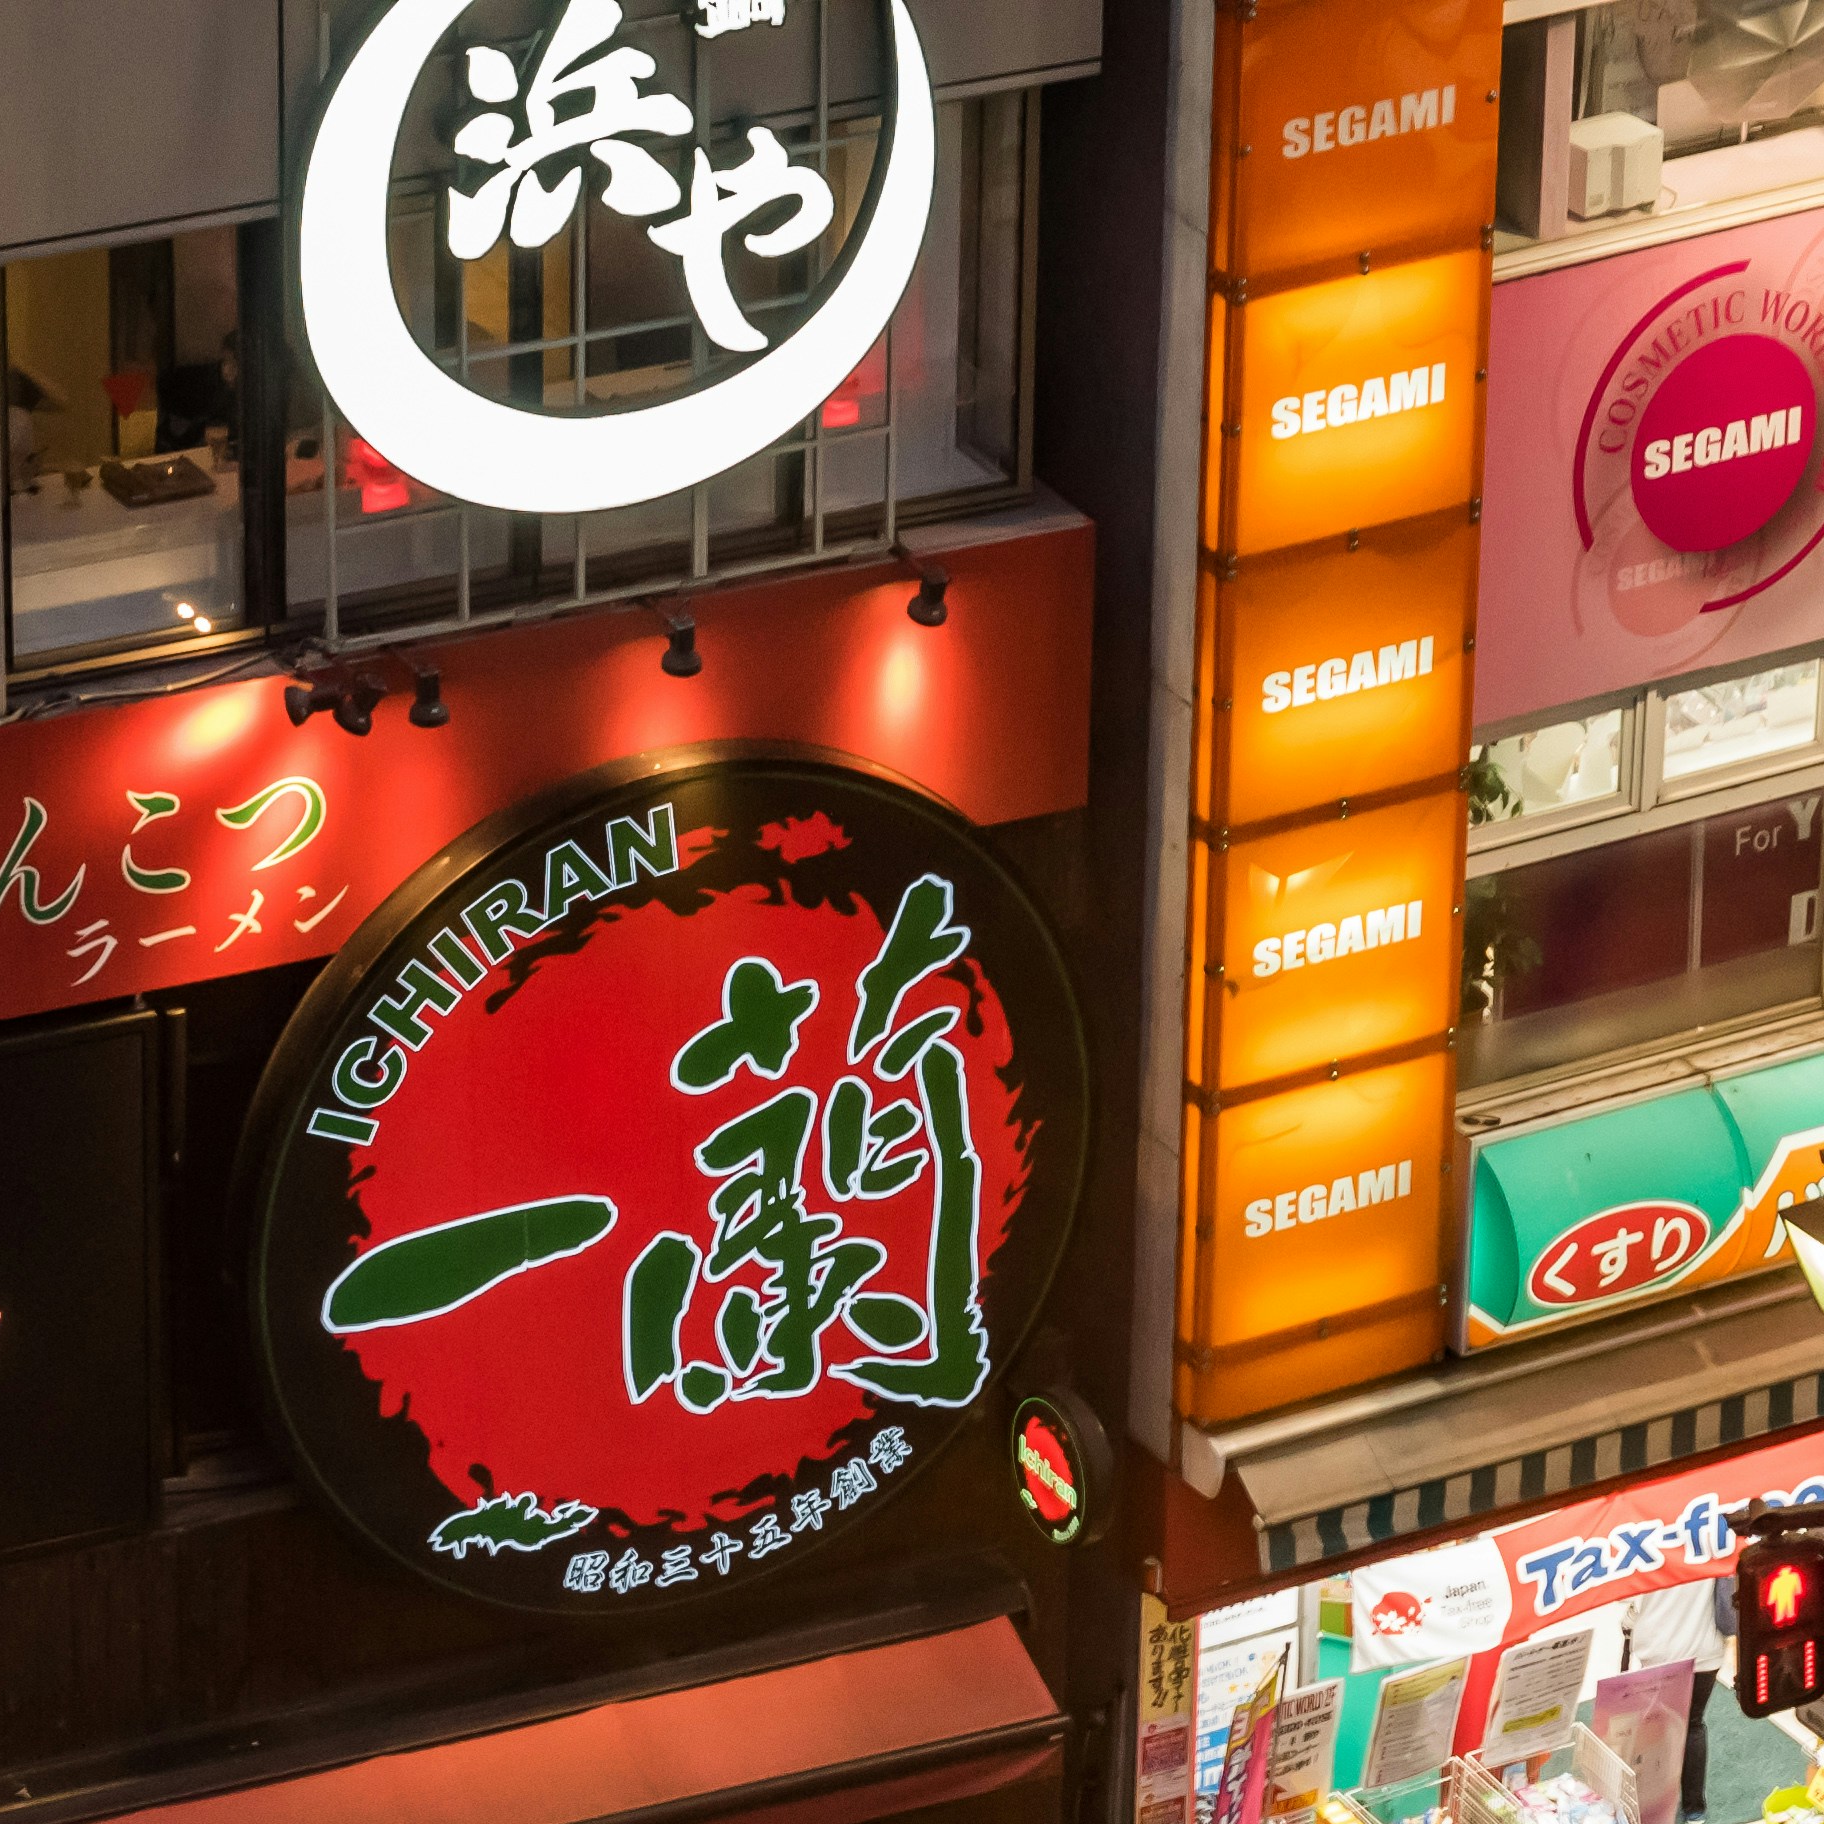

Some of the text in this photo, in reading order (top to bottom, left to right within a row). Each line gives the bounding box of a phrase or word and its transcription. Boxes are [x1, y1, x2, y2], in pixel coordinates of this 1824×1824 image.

[1282, 84, 1456, 160] SEGAMI
[448, 0, 836, 352] 浜や
[1271, 362, 1446, 441] SEGAMI
[1599, 289, 1746, 454] COSMETIC
[1643, 405, 1802, 481] SEGAMI
[1261, 635, 1435, 714] SEGAMI
[1735, 820, 1781, 857] For
[66, 880, 351, 989] ラーメン
[307, 801, 678, 1147] ICHIRAN
[1253, 900, 1423, 978] SEGAMI
[320, 873, 991, 1414] 一蘭
[1245, 1159, 1413, 1239] SEGAMI
[1543, 1215, 1692, 1297] くすり
[562, 1424, 915, 1594] 昭和三十五年創業
[1018, 1433, 1078, 1510] Ichiran
[1445, 1579, 1486, 1599] Japan
